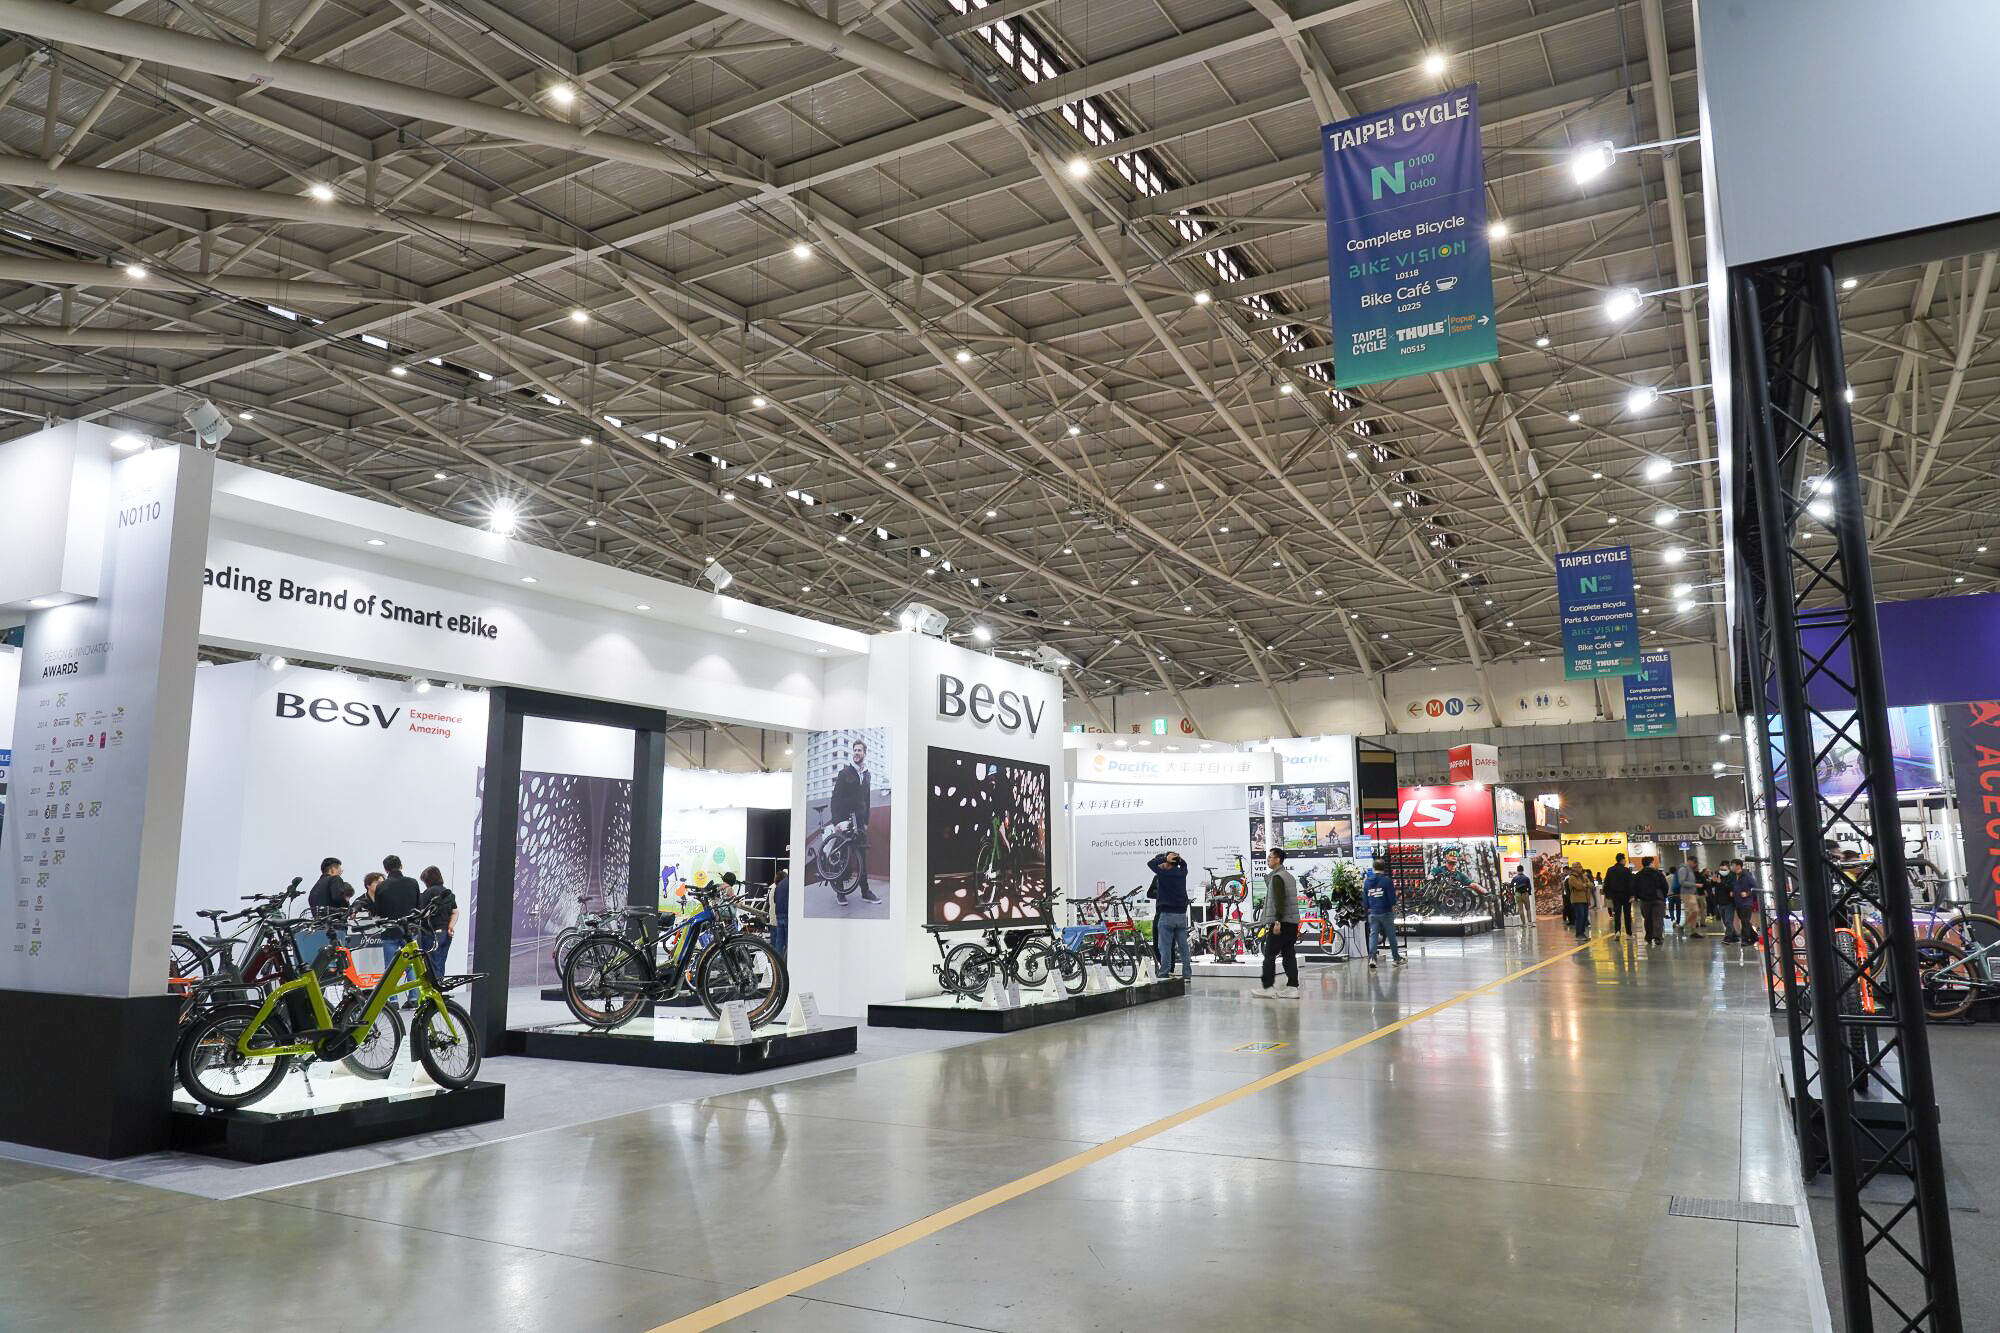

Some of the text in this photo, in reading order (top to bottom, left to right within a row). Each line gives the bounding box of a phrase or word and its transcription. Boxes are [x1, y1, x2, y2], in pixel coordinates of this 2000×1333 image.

[1330, 97, 1469, 151] TAIPEI CYCLE
[1408, 153, 1435, 168] 0100
[1371, 160, 1405, 200] N
[1410, 176, 1436, 191] 0400
[1346, 216, 1465, 251] Complete Bicycle
[1349, 240, 1466, 279] BIKE VISION
[1395, 269, 1419, 280] L0118
[1361, 280, 1431, 308] Bike Café
[1398, 302, 1421, 313] L0225
[1352, 328, 1386, 344] TAIPEI
[1396, 321, 1445, 342] THULE
[1352, 339, 1387, 356] CYCLE
[1401, 344, 1426, 355] N0515
[118, 501, 161, 528] N0110
[1560, 551, 1627, 567] TAIPEI CYCLE
[1580, 576, 1598, 593] N
[279, 579, 347, 610] Brand
[354, 596, 377, 615] of
[380, 599, 443, 629] Smart
[447, 614, 498, 639] eBike
[1569, 601, 1626, 612] Complete Bicycle
[1591, 612, 1633, 621] Components
[43, 662, 78, 678] AWARDS
[1429, 702, 1441, 714] M
[1449, 701, 1460, 713] N
[410, 709, 462, 724] Experience
[409, 723, 451, 738] Amazing
[1108, 760, 1159, 773] Pacific
[1166, 760, 1251, 774] 太平洋自行車
[1076, 799, 1143, 810] 太平洋自行車
[1091, 839, 1113, 848] Pacific
[1115, 839, 1136, 848] Cycles
[1144, 836, 1198, 847] sectionzero
